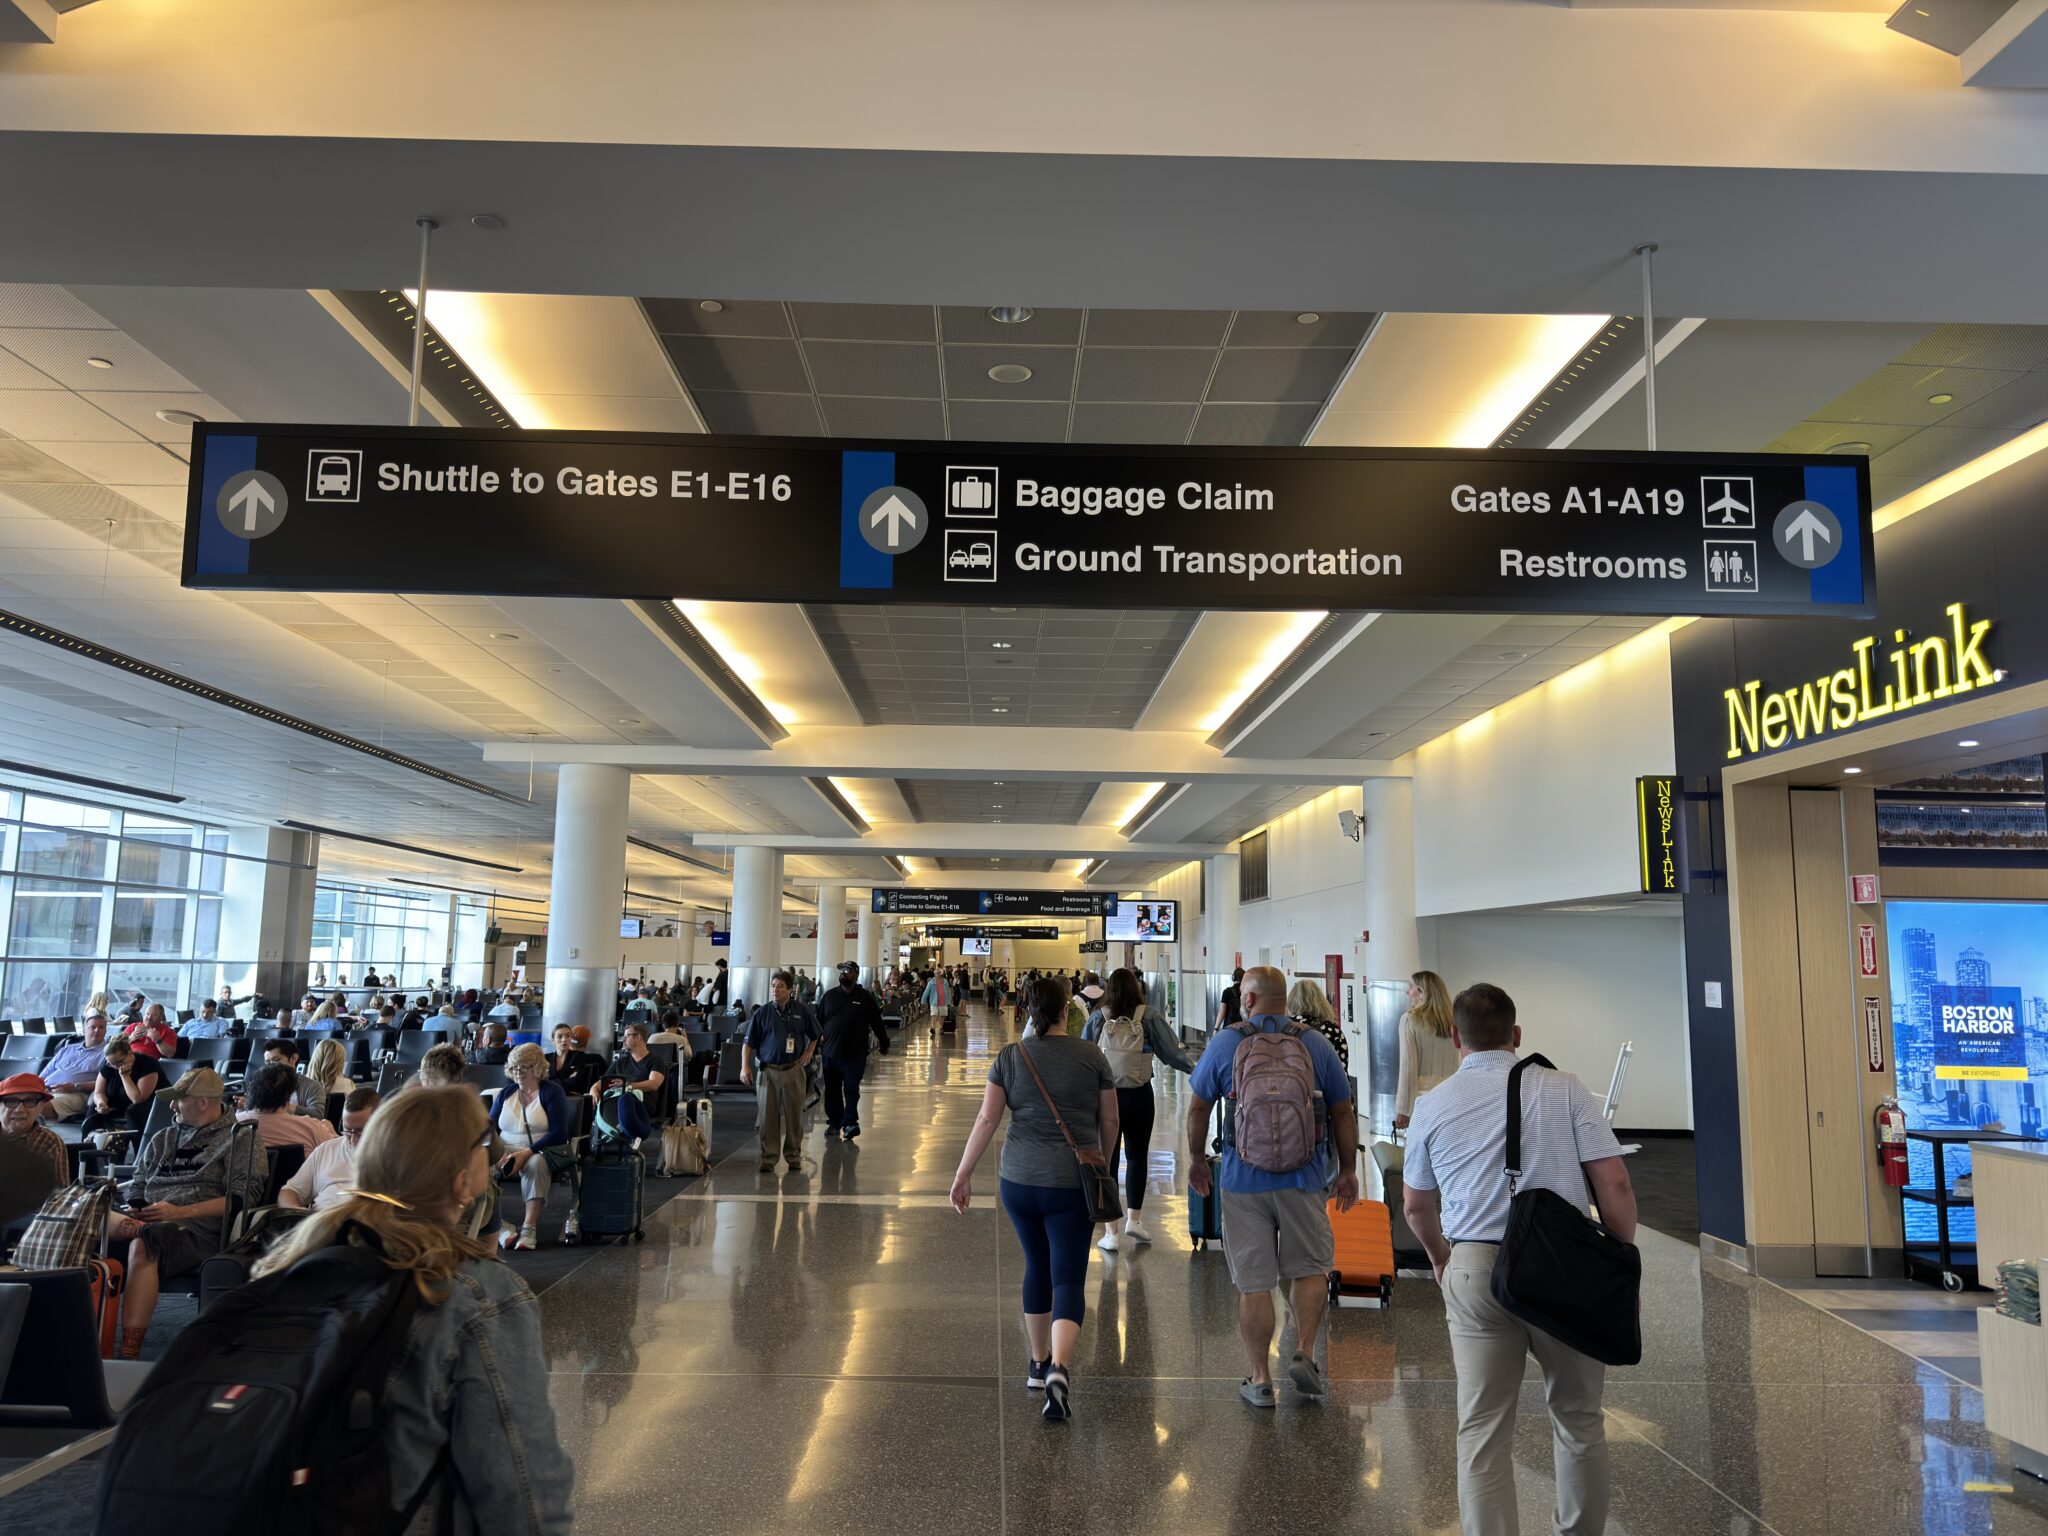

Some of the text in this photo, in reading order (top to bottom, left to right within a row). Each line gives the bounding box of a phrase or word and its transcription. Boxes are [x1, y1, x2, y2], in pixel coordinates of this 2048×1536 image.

[377, 462, 792, 502] Shuttle to Gates E1-E16
[1016, 479, 1274, 516] Baggage Claim
[1450, 484, 1685, 516] Gates A1-A19
[1015, 542, 1402, 582] Ground Transportation
[1500, 549, 1687, 580] Restrooms
[1657, 781, 1675, 888] NewsLink
[1942, 1005, 2013, 1020] BOSTON
[1943, 1019, 2015, 1034] HARBOR
[1871, 1010, 1879, 1065] EXTINGUISHER
